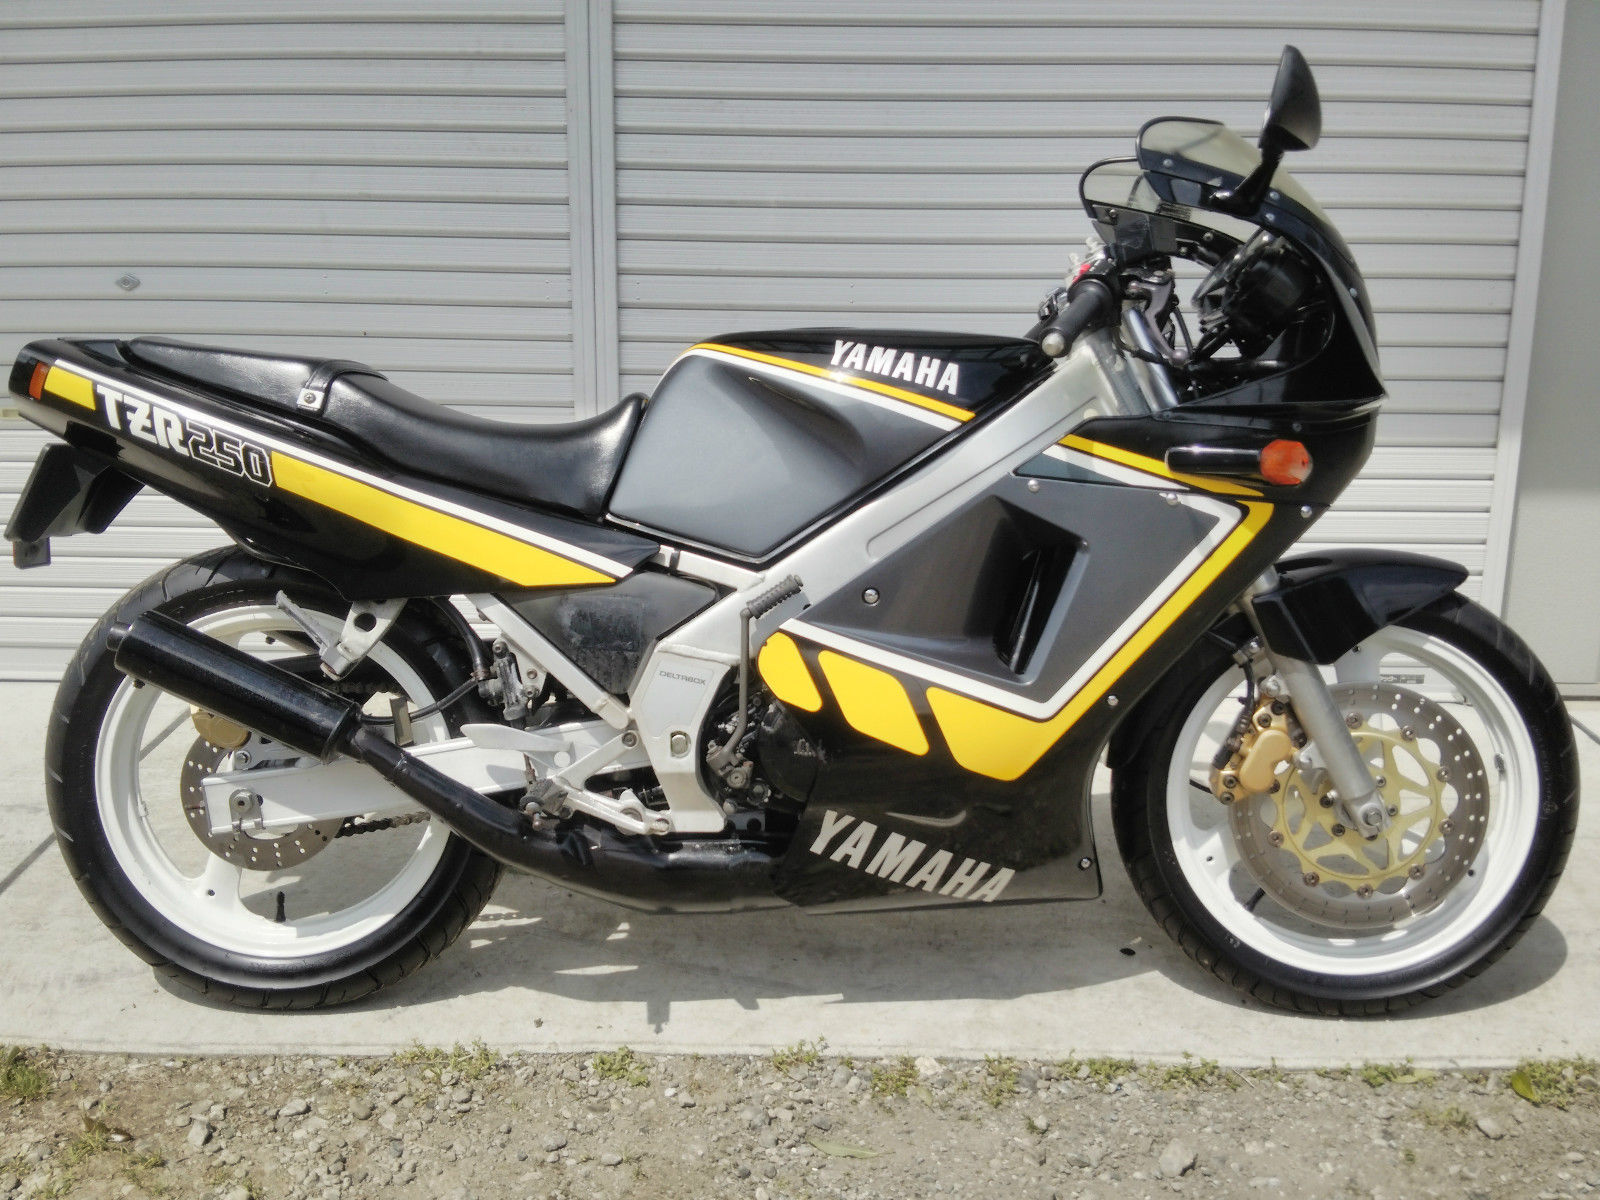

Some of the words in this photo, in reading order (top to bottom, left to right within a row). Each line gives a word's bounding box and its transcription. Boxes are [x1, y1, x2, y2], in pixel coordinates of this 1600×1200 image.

[830, 339, 960, 396] YAMAHA
[659, 670, 706, 686] DELTABOX
[809, 809, 1016, 903] YAMAHA
